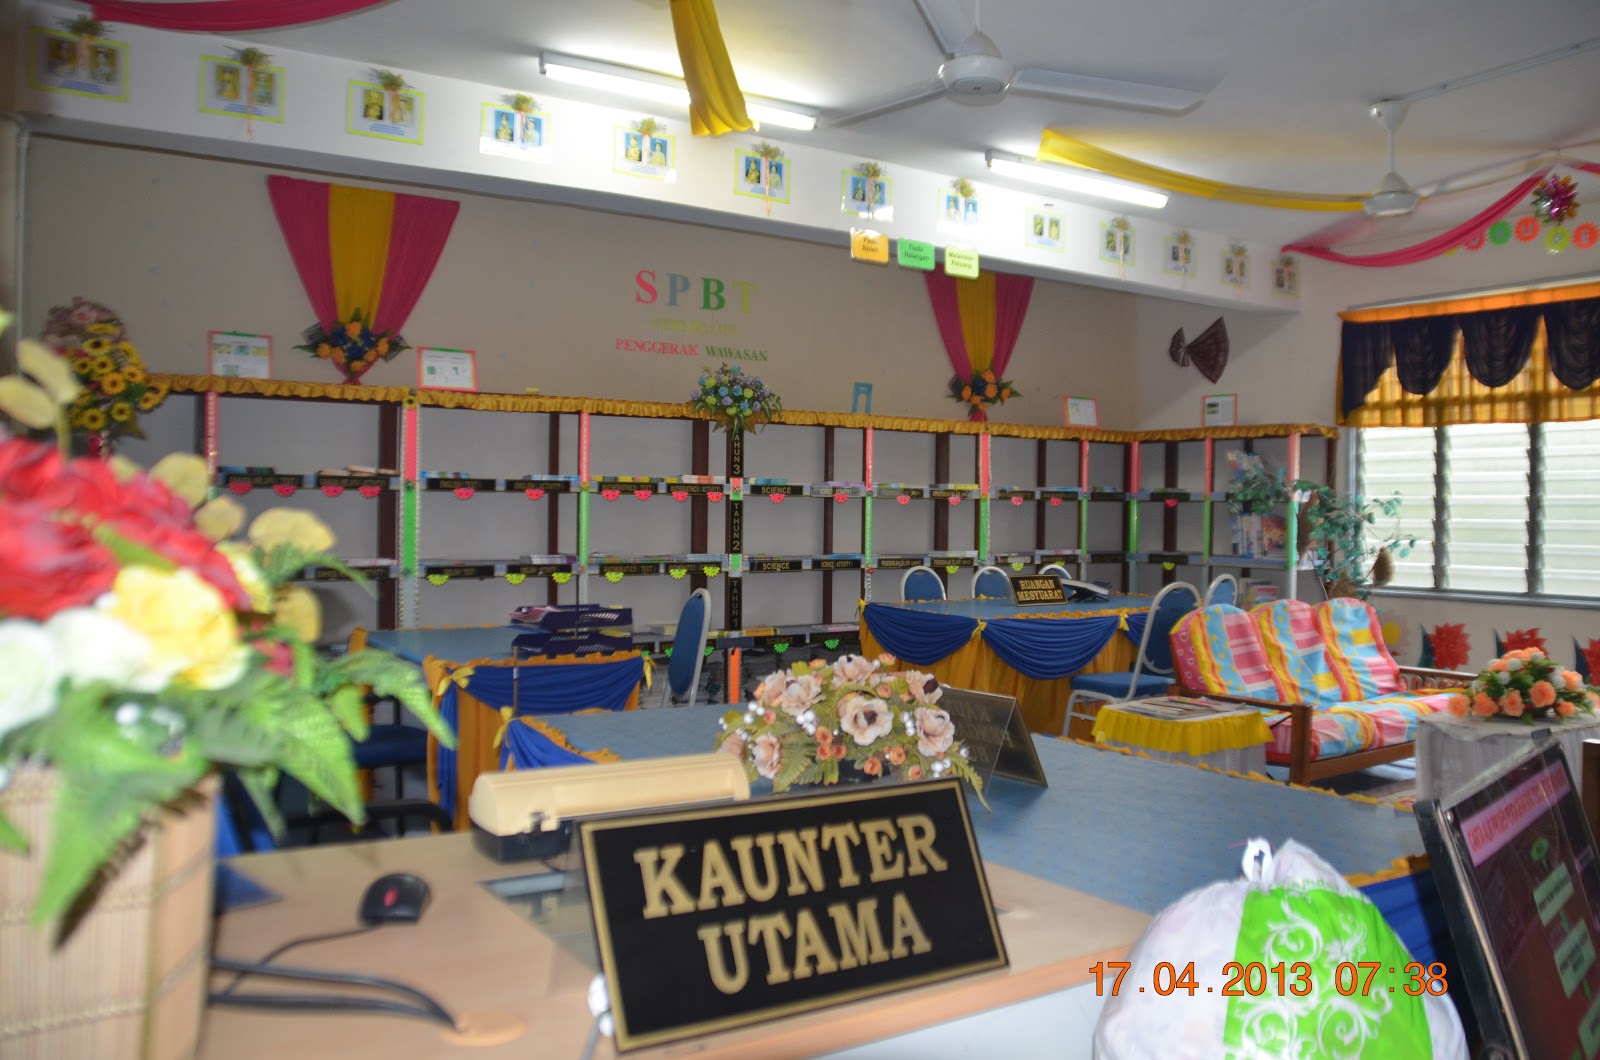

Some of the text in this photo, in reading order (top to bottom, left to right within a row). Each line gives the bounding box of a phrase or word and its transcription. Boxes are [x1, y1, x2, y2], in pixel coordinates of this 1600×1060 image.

[909, 244, 923, 252] Tiada
[635, 269, 759, 314] SPBT
[615, 337, 768, 362] PENGGERAK WAWASAN
[733, 433, 741, 475] AHUN 3
[761, 486, 792, 494] SCIENCE
[733, 541, 740, 550] 2
[763, 562, 790, 570] SCIENCE
[1019, 580, 1055, 590] RUANGAN
[1017, 590, 1063, 601] MESYUARAT
[634, 813, 948, 919] KAUNTER
[697, 892, 932, 994] UTAMA
